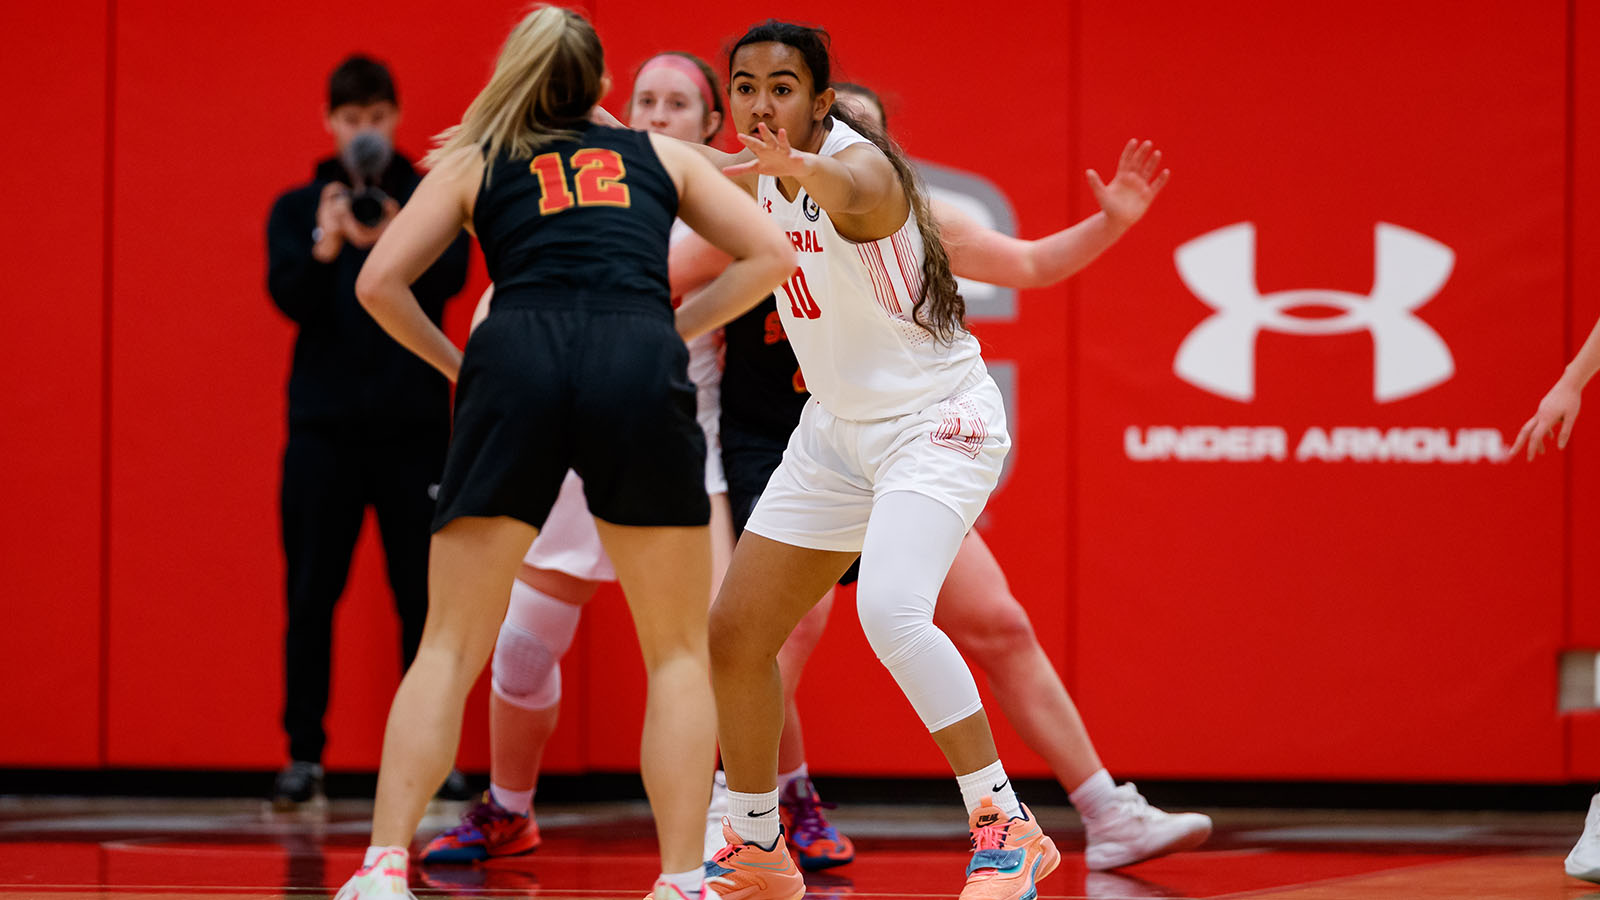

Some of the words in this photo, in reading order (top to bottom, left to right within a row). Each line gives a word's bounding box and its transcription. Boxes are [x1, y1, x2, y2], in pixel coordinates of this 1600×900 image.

[530, 148, 631, 216] 12
[785, 229, 824, 253] RAL
[781, 266, 822, 320] 10
[1125, 426, 1287, 461] UNDER
[1297, 427, 1503, 462] ARMOUR
